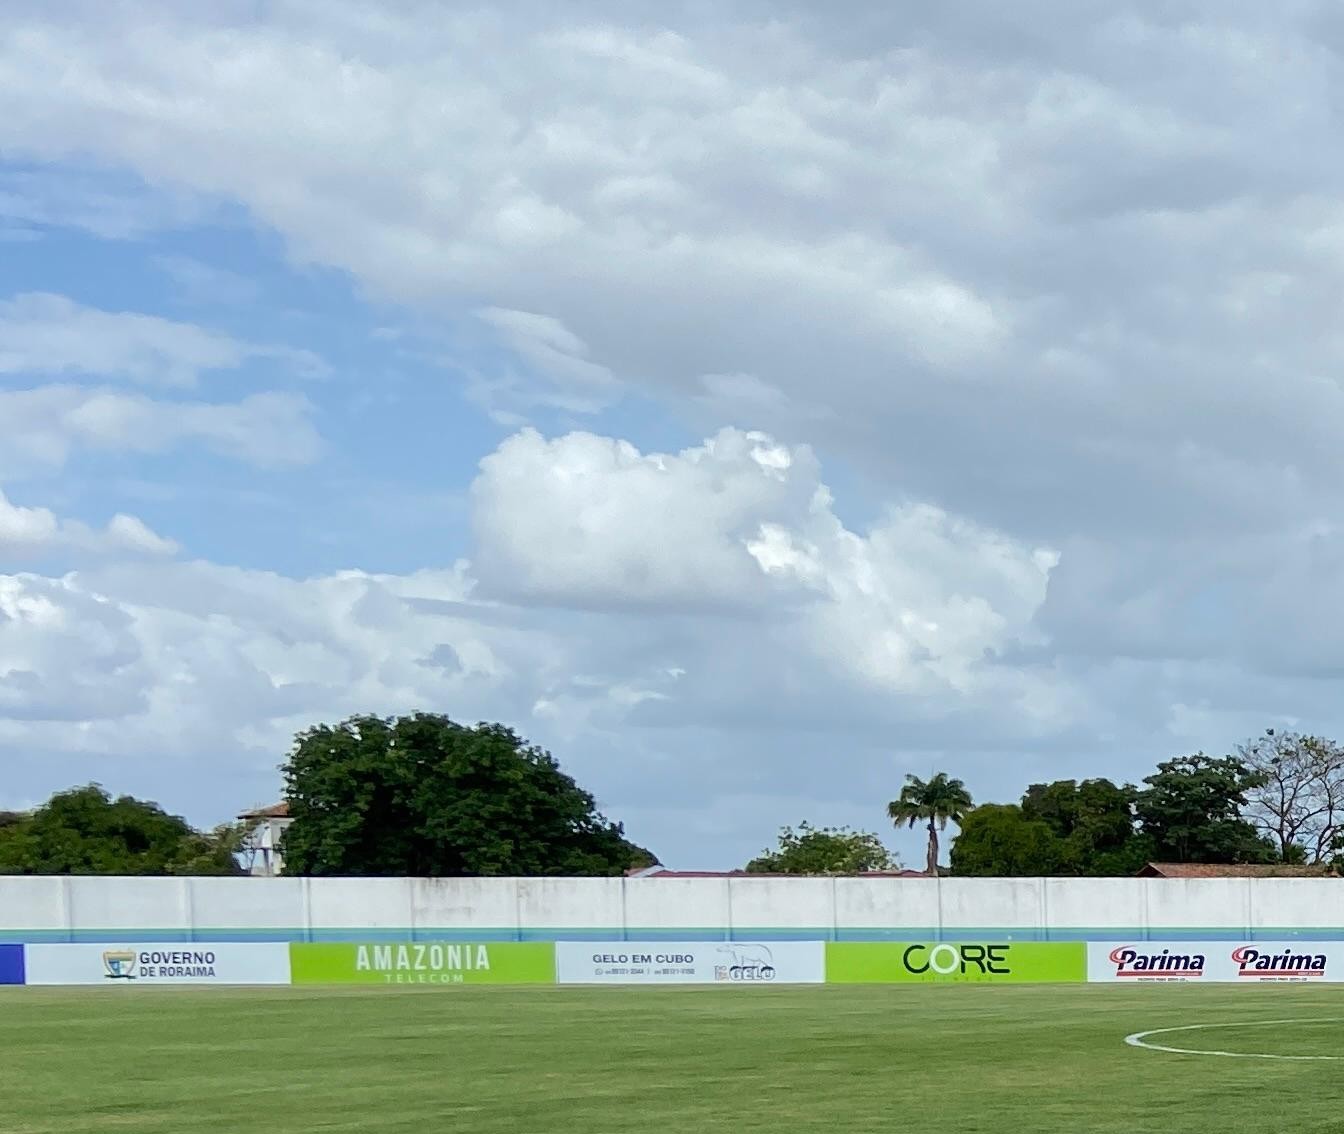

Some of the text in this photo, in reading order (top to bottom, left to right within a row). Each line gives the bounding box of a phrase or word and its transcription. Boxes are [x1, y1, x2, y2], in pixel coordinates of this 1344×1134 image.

[140, 951, 216, 967] GOVERNO
[356, 944, 490, 971] AMAZONIA
[592, 954, 694, 964] GELO EM CUBO
[902, 944, 1011, 974] CORE
[1117, 949, 1205, 970] Parima
[1239, 948, 1327, 970] Parima
[140, 966, 216, 978] DE RORAIMA
[384, 973, 465, 984] TELECOM
[729, 965, 776, 981] GELO
